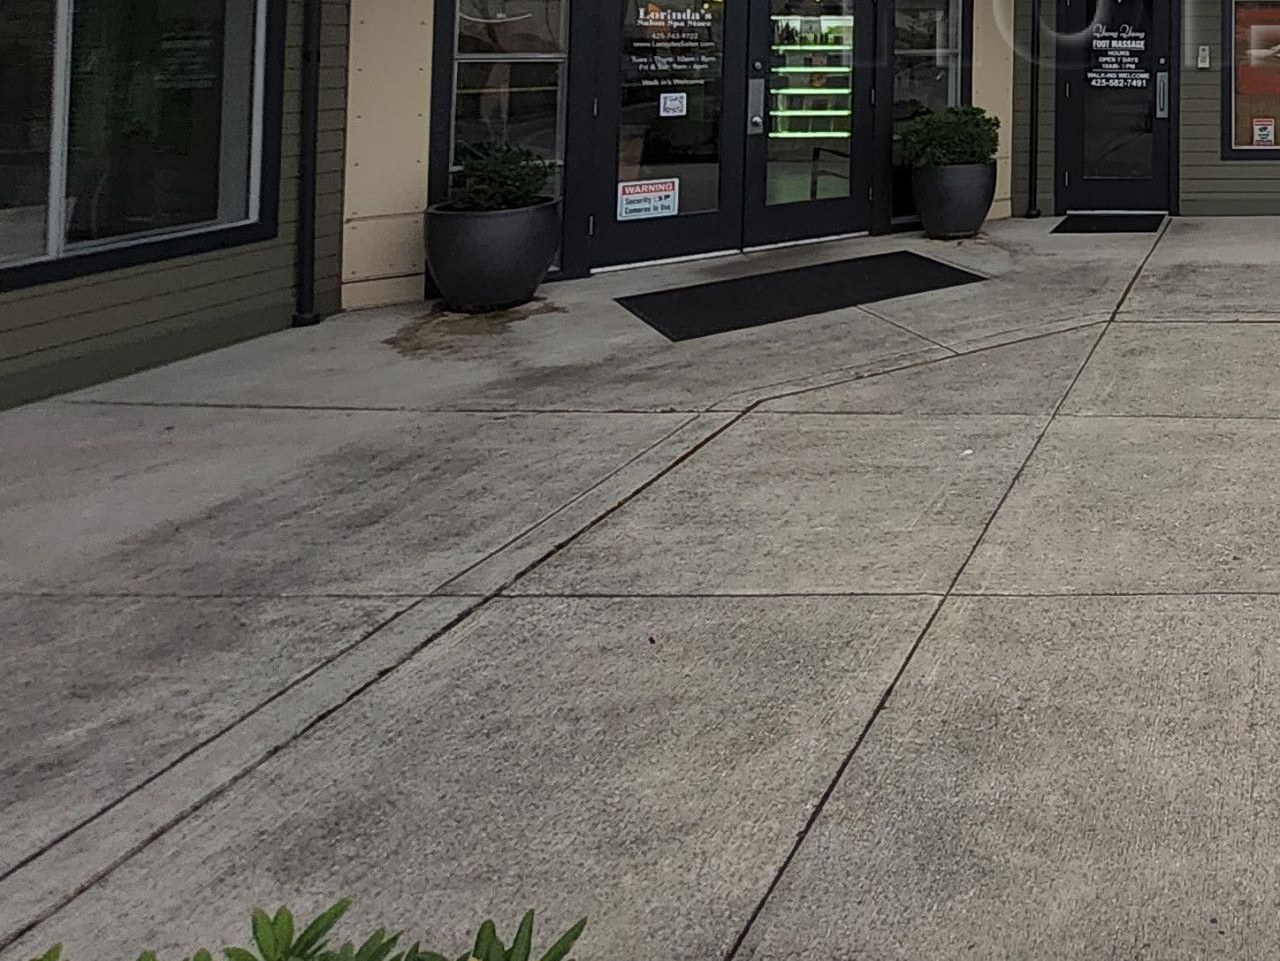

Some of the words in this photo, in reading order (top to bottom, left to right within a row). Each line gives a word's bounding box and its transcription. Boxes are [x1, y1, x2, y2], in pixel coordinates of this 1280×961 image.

[638, 7, 713, 20] Lorinda's
[1093, 39, 1110, 49] FOOT
[1111, 39, 1145, 49] MASSAGE
[624, 182, 673, 195] WARNING
